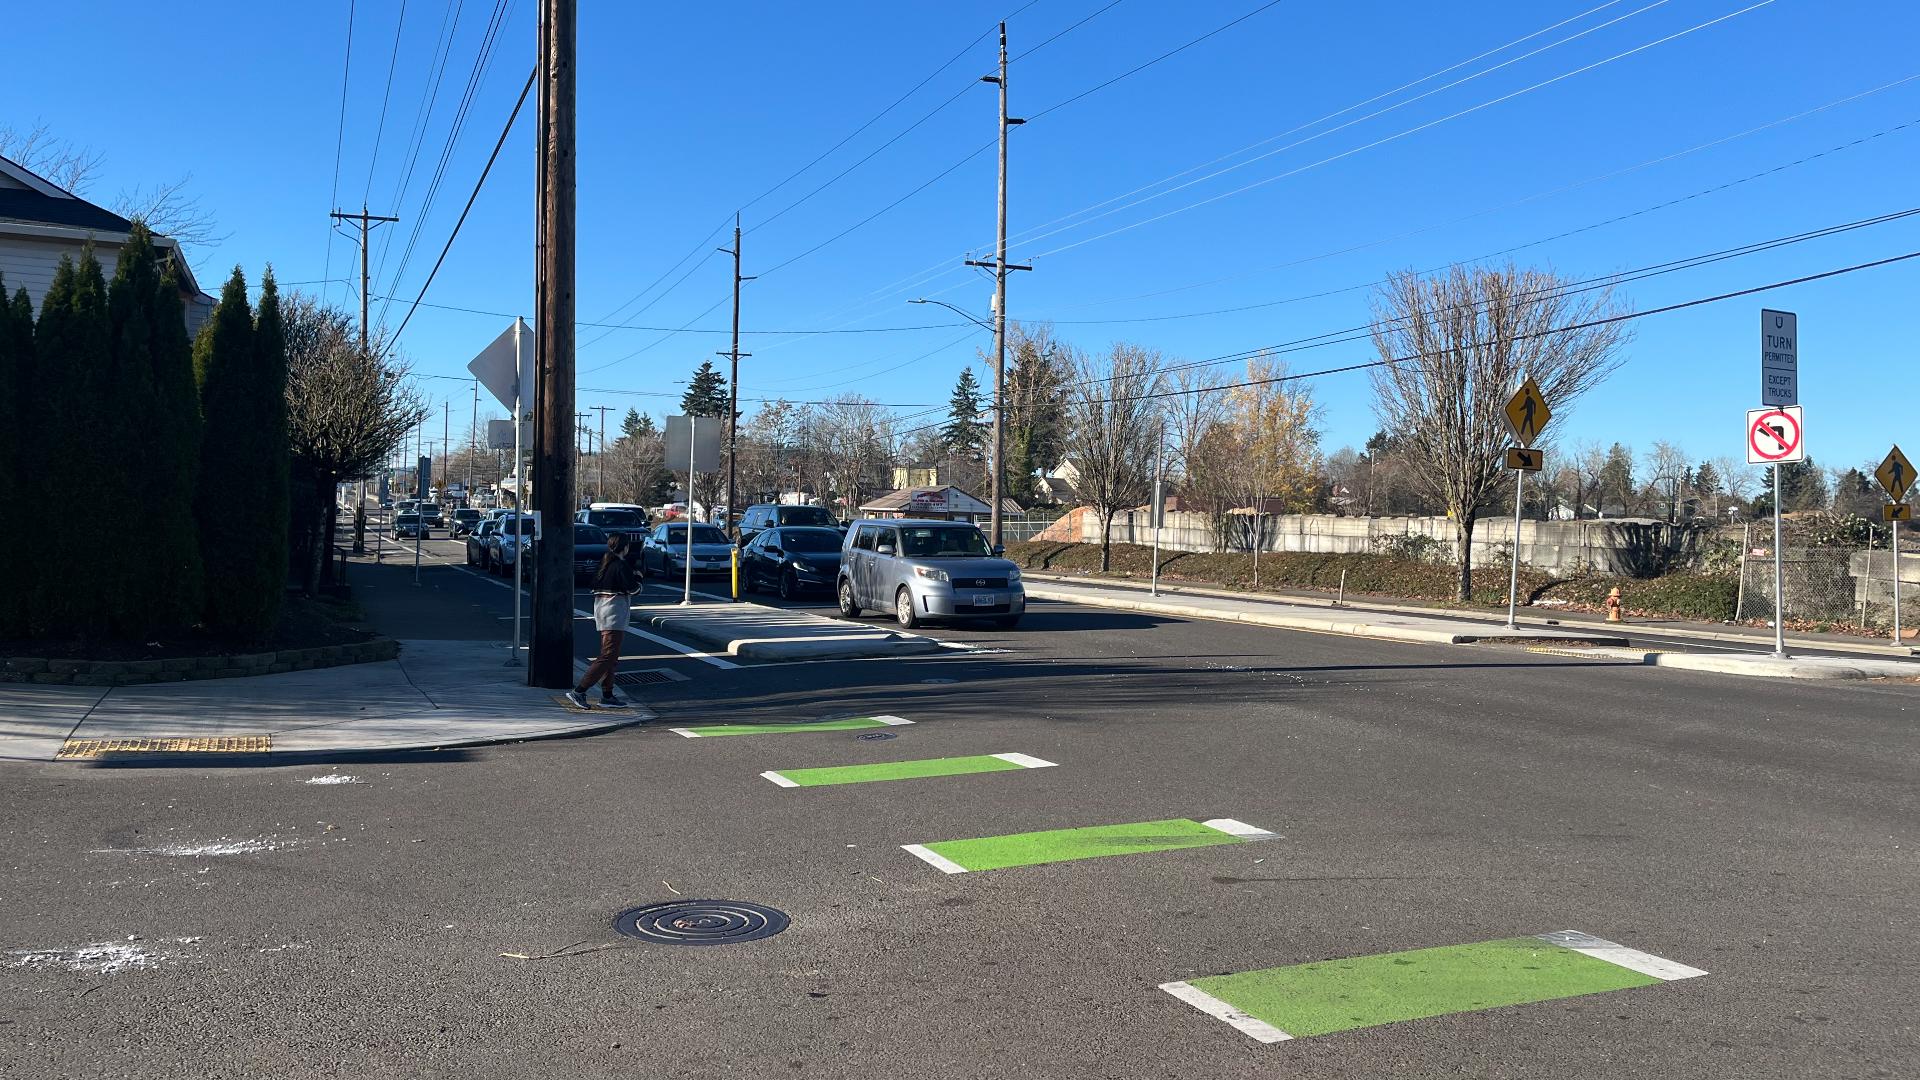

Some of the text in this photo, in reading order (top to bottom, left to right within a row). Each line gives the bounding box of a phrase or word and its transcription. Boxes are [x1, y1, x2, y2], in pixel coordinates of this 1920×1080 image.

[1775, 316, 1784, 329] U
[1767, 335, 1792, 350] TURN
[1764, 351, 1795, 364] PERMITTED
[1768, 374, 1792, 386] EXCEPT
[1768, 387, 1792, 398] TRUCKS
